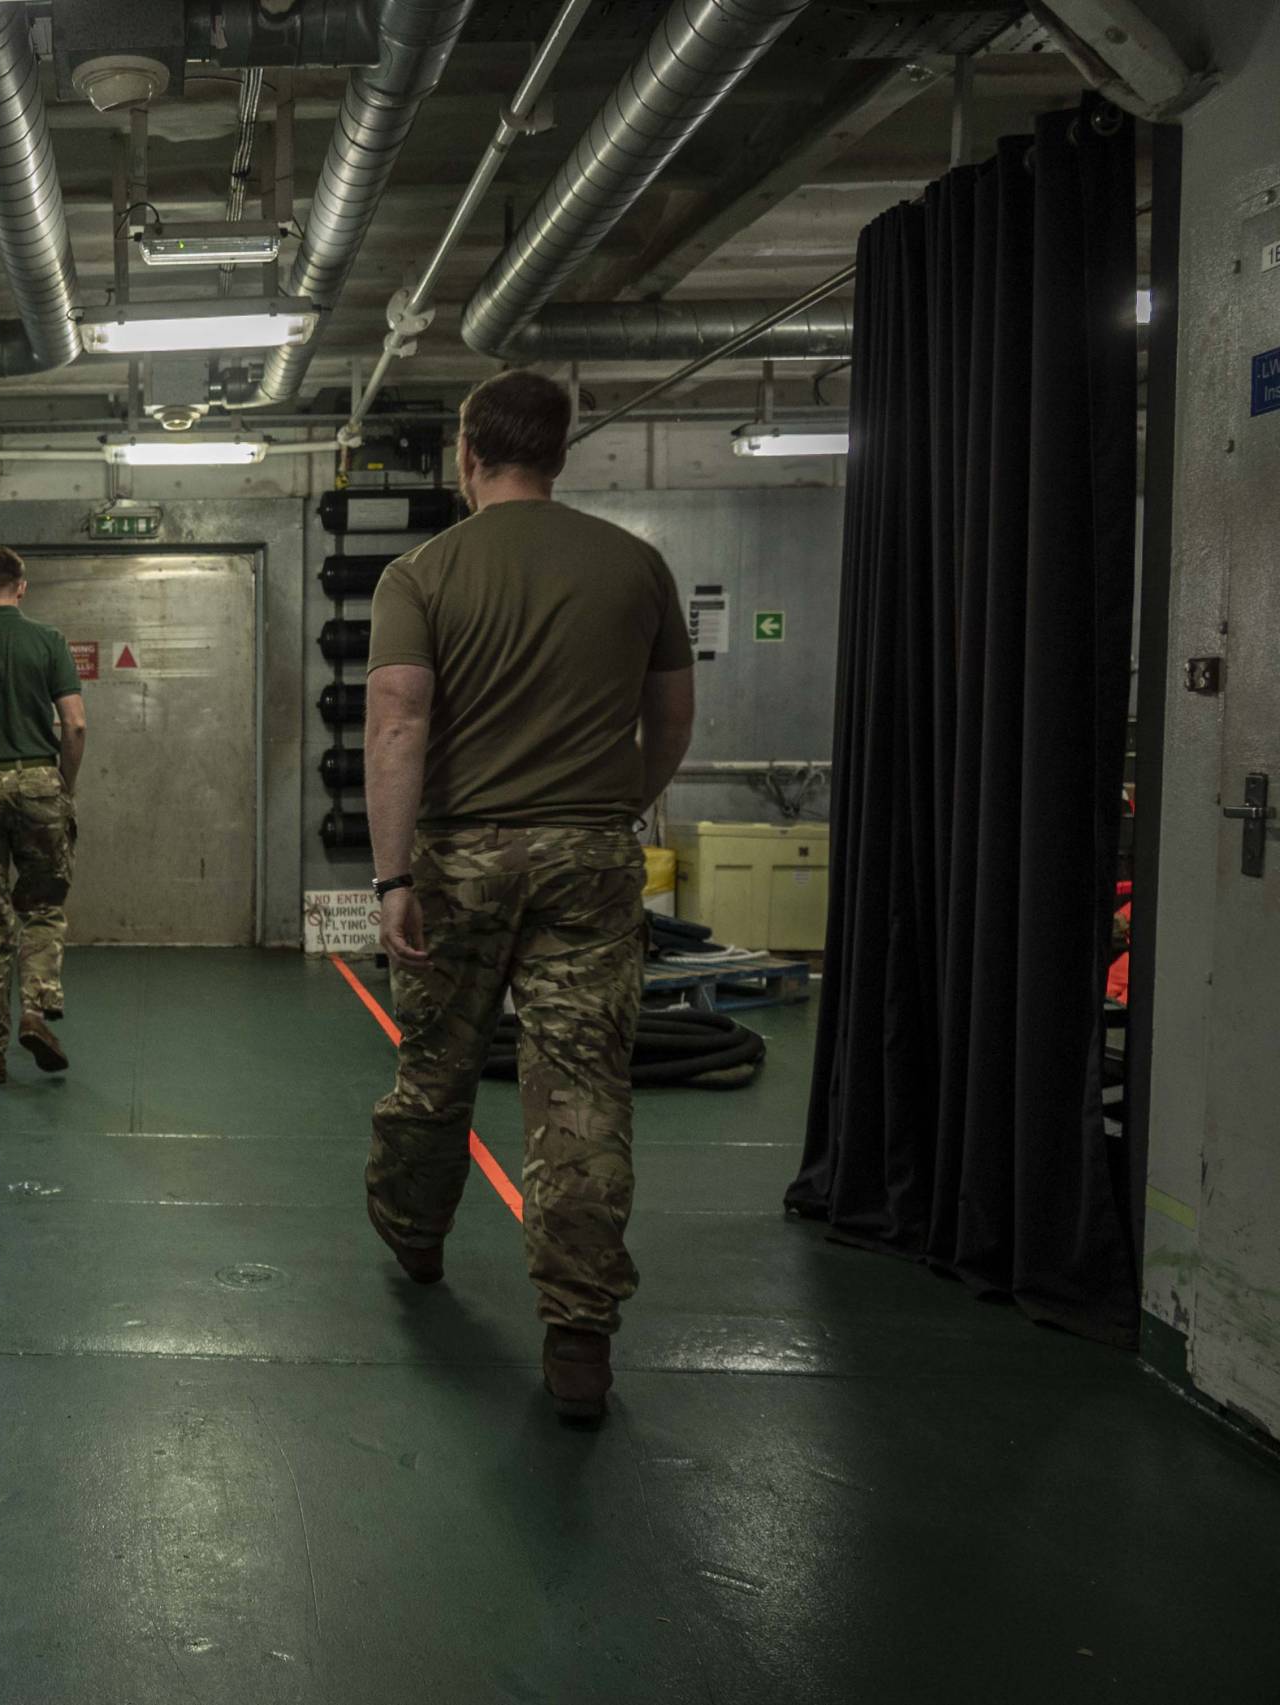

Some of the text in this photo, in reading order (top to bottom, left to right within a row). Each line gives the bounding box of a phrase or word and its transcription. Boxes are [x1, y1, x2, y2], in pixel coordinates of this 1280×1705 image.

[314, 893, 376, 904] NO ENTRY
[323, 906, 366, 917] DURING
[325, 919, 367, 931] FLYING
[316, 934, 376, 945] STATIONS
